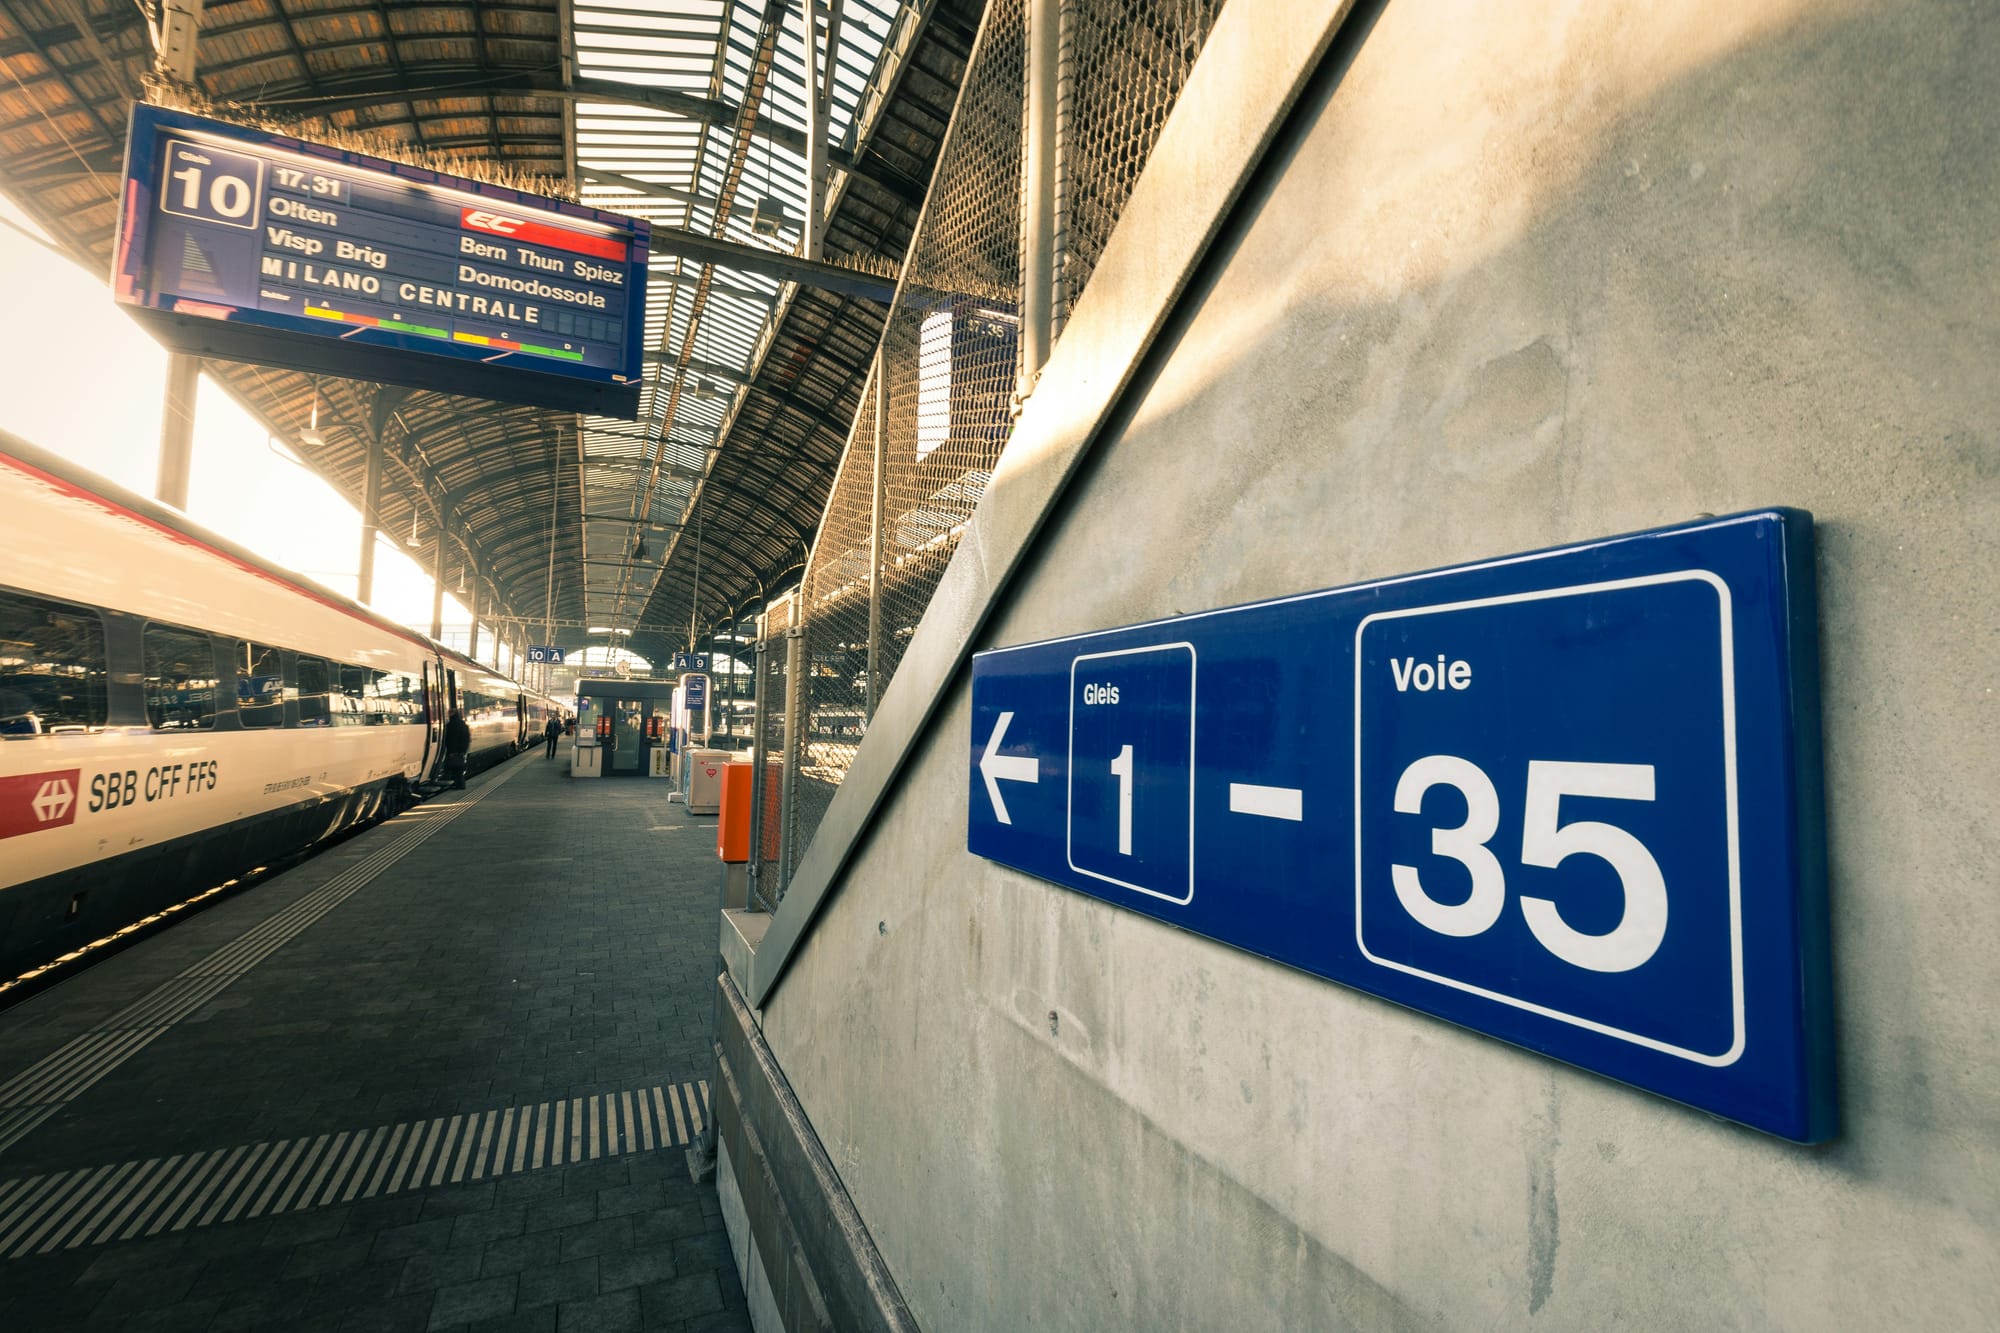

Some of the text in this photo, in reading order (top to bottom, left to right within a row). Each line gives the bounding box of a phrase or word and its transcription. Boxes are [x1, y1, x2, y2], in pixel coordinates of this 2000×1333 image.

[173, 166, 251, 219] 10
[276, 168, 341, 198] 17.31
[268, 196, 338, 227] Olten
[465, 210, 526, 234] EC
[266, 226, 388, 270] Visp Brig
[460, 236, 624, 285] Bern Thun Spiez
[261, 256, 540, 324] MILANO CENTRALE
[458, 265, 606, 309] Domodossola
[530, 650, 544, 661] 10
[551, 651, 561, 662] A
[678, 658, 687, 668] A
[696, 659, 704, 668] 9
[1390, 655, 1473, 693] Voie
[1083, 682, 1120, 706] Gleis
[88, 769, 138, 813] SBB
[144, 763, 183, 802] CFF
[186, 759, 218, 794] FFS
[1110, 744, 1134, 856] 1
[1391, 755, 1669, 974] 35
